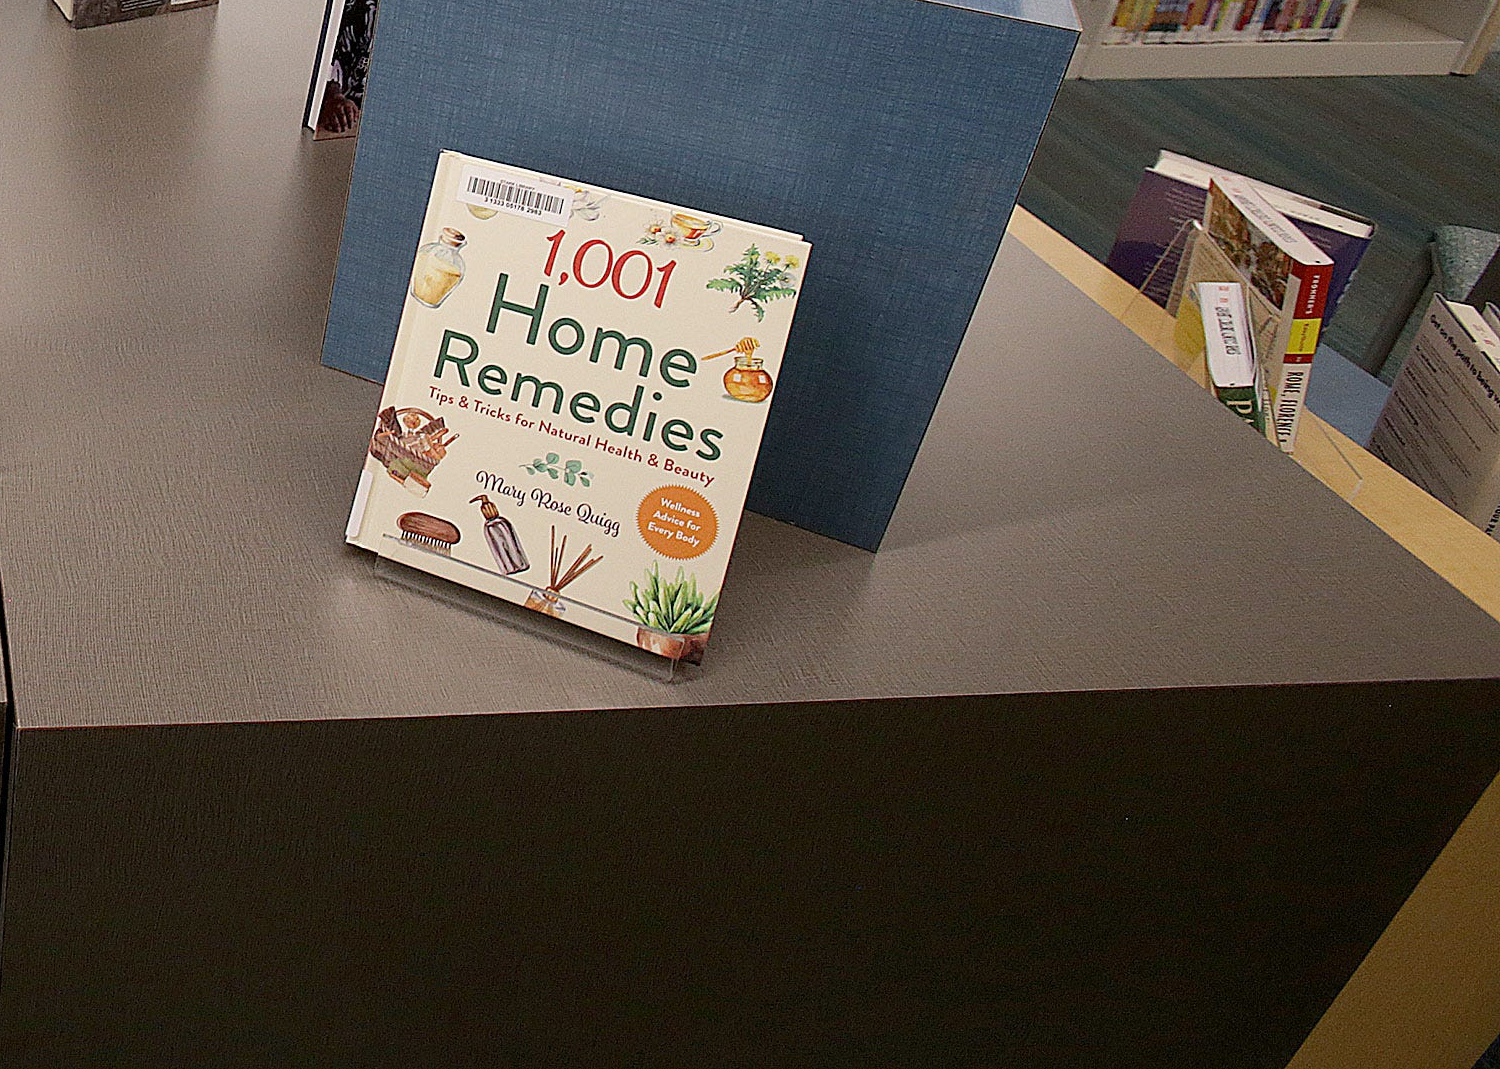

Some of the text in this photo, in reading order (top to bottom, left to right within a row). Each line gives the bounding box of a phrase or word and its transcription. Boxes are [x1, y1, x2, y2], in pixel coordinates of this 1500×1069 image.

[544, 229, 677, 308] 1,001
[486, 273, 698, 388] Home
[434, 329, 724, 461] Remedies
[1277, 399, 1298, 435] FLORENCE
[428, 385, 716, 488] Tips & Tricks for Natural Health & Beauty
[476, 470, 621, 538] Mary Rose Quigg
[647, 521, 701, 548] Every Body
[652, 510, 701, 532] Advice for
[660, 497, 701, 518] Wellness
